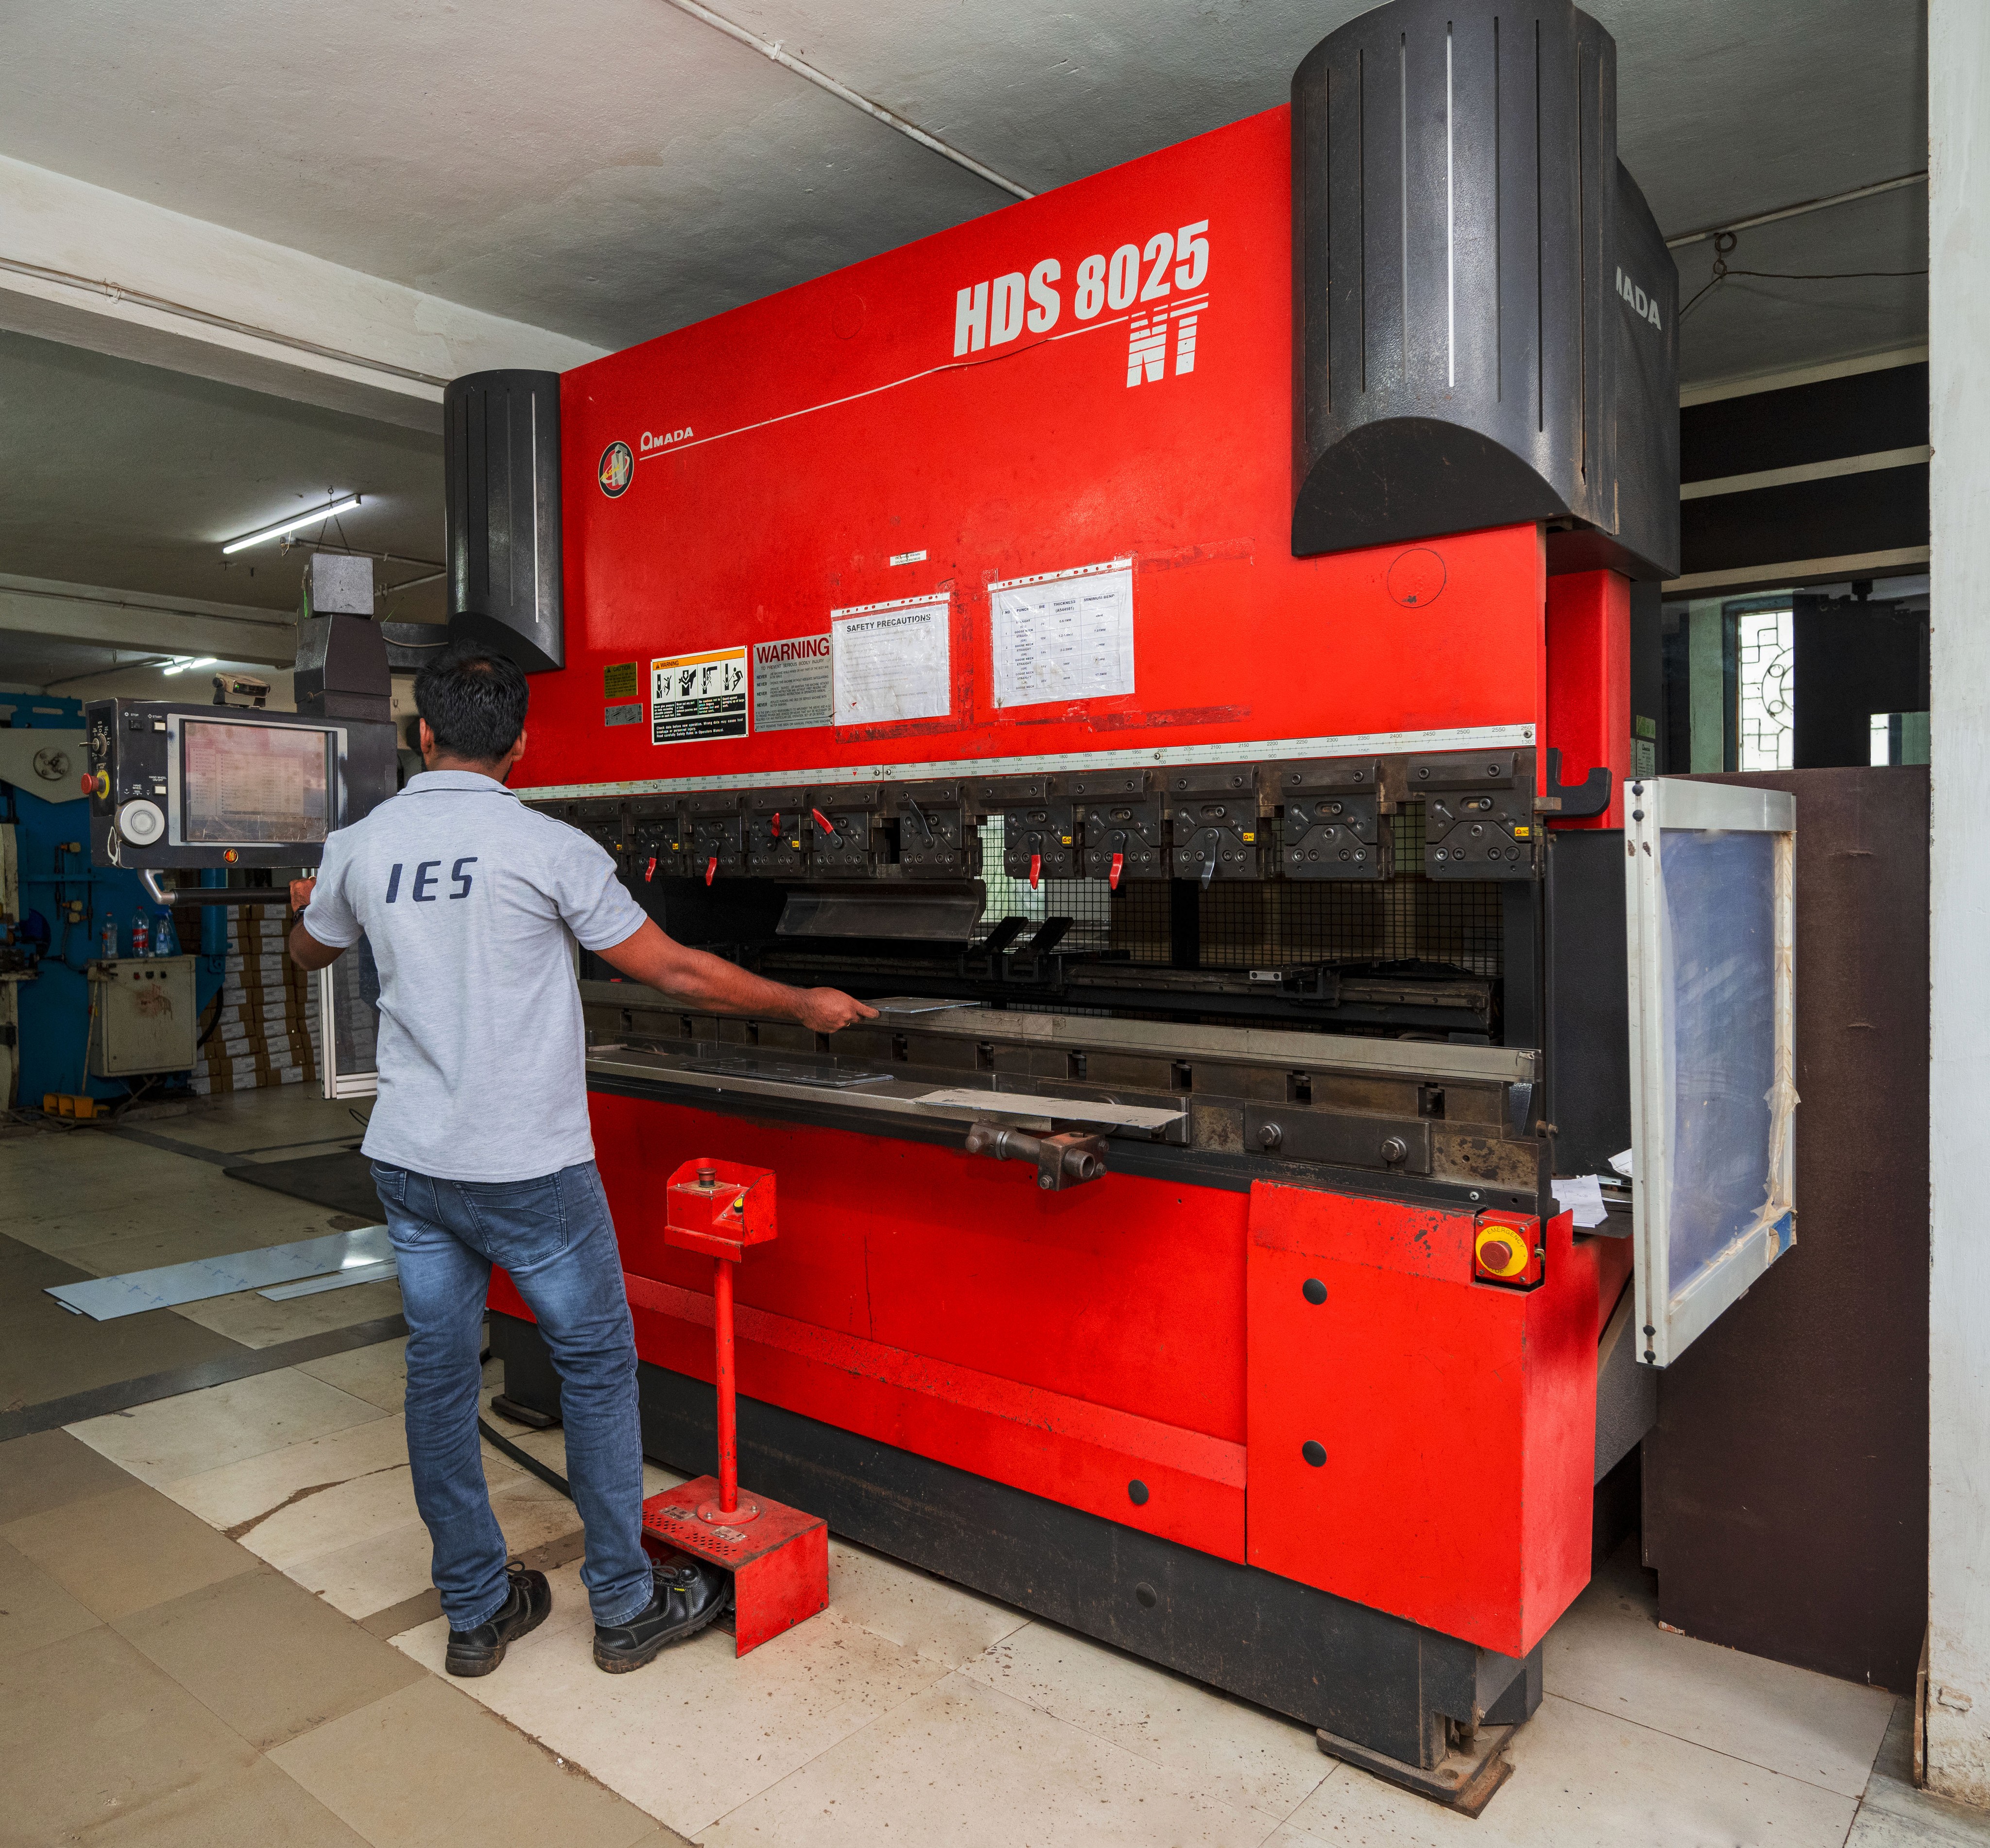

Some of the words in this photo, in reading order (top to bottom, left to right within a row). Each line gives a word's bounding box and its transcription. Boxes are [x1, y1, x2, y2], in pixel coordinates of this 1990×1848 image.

[954, 259, 1061, 357] HDS
[1075, 219, 1209, 320] 8025
[1127, 293, 1209, 388] NT
[641, 427, 693, 451] AMADA
[847, 622, 874, 632] SAFETY
[877, 614, 930, 628] PRECAUTIONS
[756, 638, 829, 664] WARNING
[386, 857, 478, 903] IES
[1487, 1227, 1525, 1247] EMERGENCY
